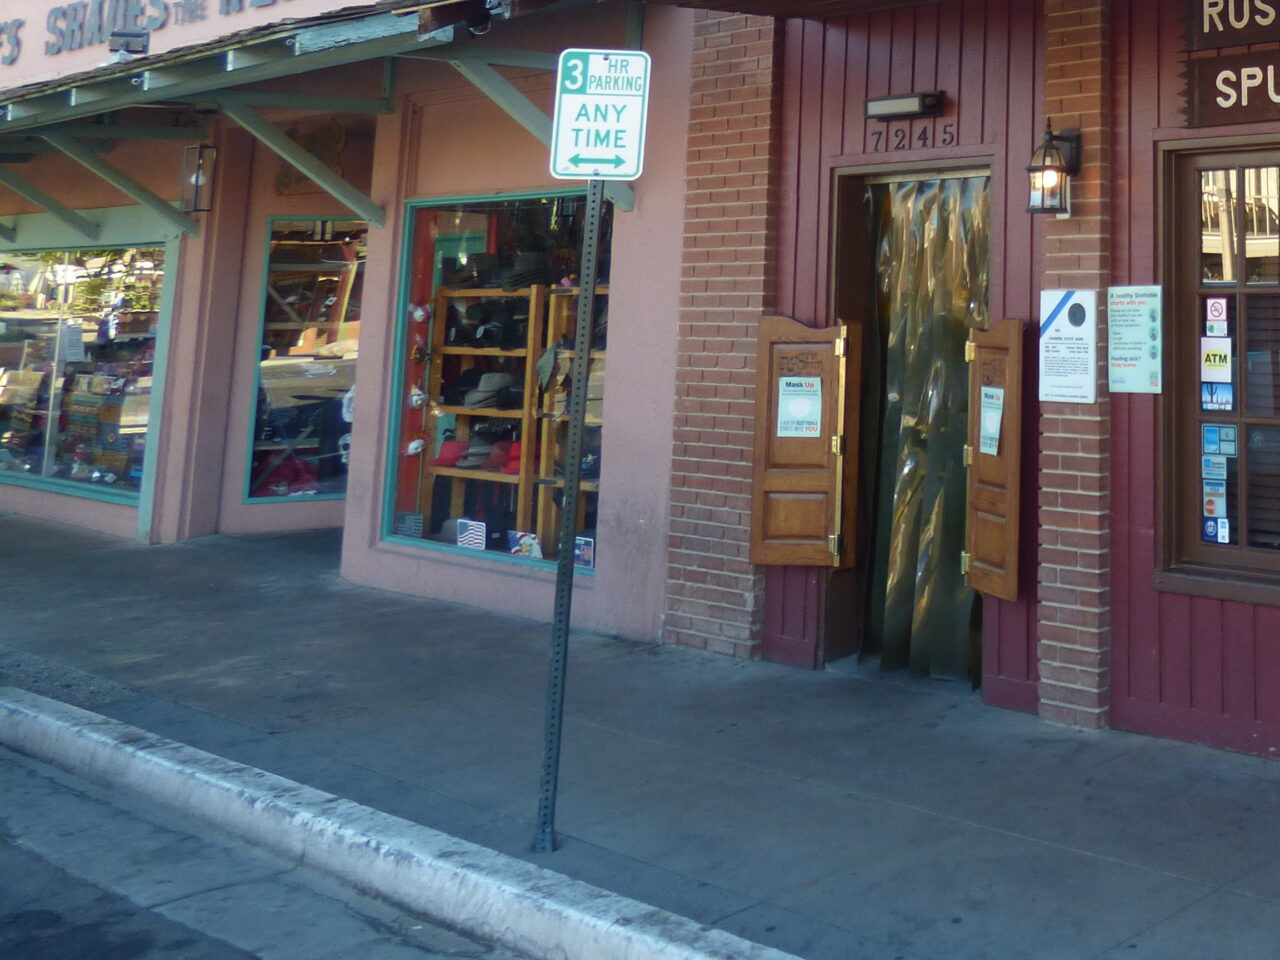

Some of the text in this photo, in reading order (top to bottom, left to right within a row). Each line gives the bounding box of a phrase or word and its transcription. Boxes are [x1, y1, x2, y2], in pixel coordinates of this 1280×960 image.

[564, 59, 584, 90] 3
[607, 58, 630, 75] HR
[588, 74, 643, 92] PARKING
[574, 103, 627, 123] ANY
[571, 128, 627, 149] TIME
[871, 123, 955, 153] 7245
[1204, 353, 1228, 365] ATM
[804, 381, 815, 389] Up
